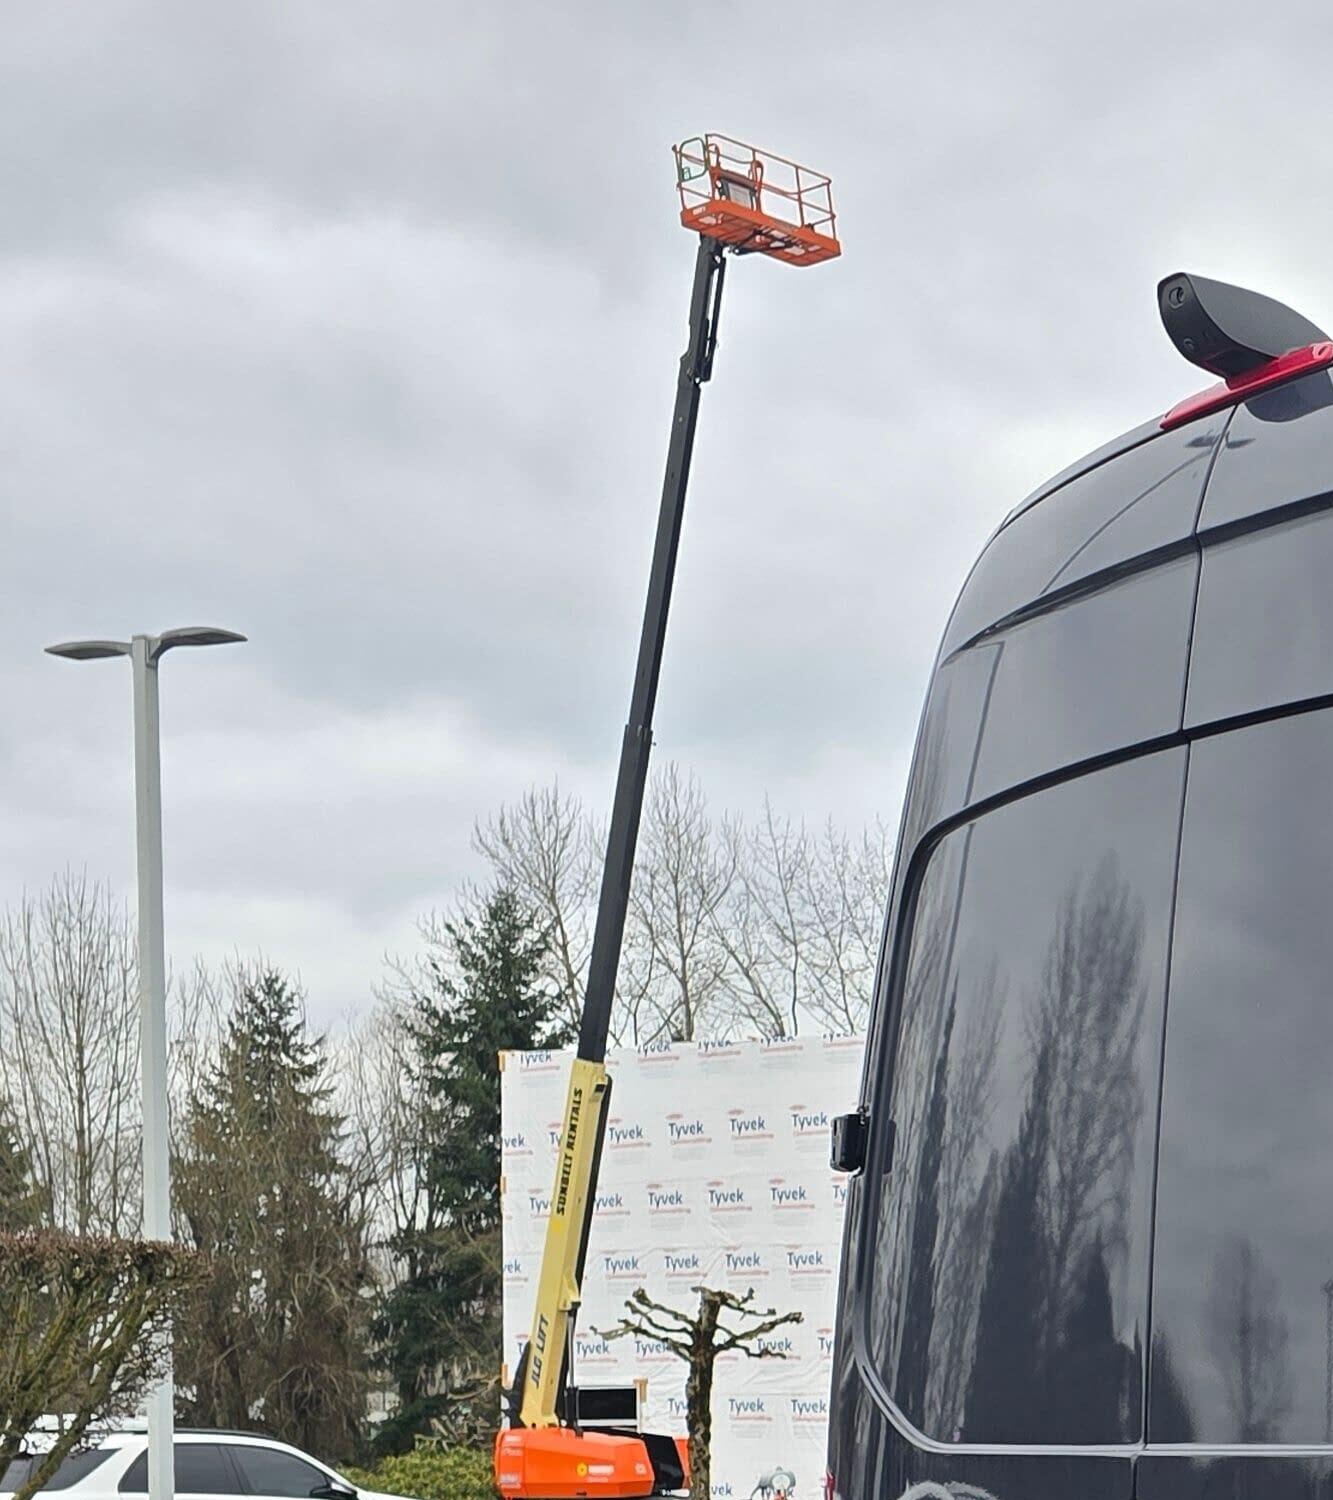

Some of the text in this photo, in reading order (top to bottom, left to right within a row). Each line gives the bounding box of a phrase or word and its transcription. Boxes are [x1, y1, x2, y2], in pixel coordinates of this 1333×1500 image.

[668, 1120, 705, 1137] Tyvek
[729, 1116, 766, 1135] Tyvek
[791, 1112, 829, 1131] Tyvek
[504, 1134, 525, 1148] vek
[609, 1125, 643, 1143] Tyvek
[556, 1153, 573, 1216] SUNBELT
[566, 1087, 583, 1152] RENTALS
[595, 1193, 623, 1211] yvek
[648, 1190, 683, 1208] Tyvek
[709, 1188, 744, 1207] Tyvek
[770, 1185, 807, 1204] Tyvek
[529, 1197, 551, 1213] Tyv
[604, 1255, 639, 1273] Tyvek
[664, 1253, 699, 1272] Tyvek
[725, 1252, 761, 1270] Tyvek
[787, 1250, 823, 1268] Tyvek
[531, 1314, 549, 1389] JLG LIFT
[576, 1340, 611, 1357] Tyvek
[668, 1398, 688, 1414] Tyv
[729, 1398, 765, 1415] Tyvek
[791, 1399, 828, 1416] Tyvek
[711, 1482, 733, 1497] vek
